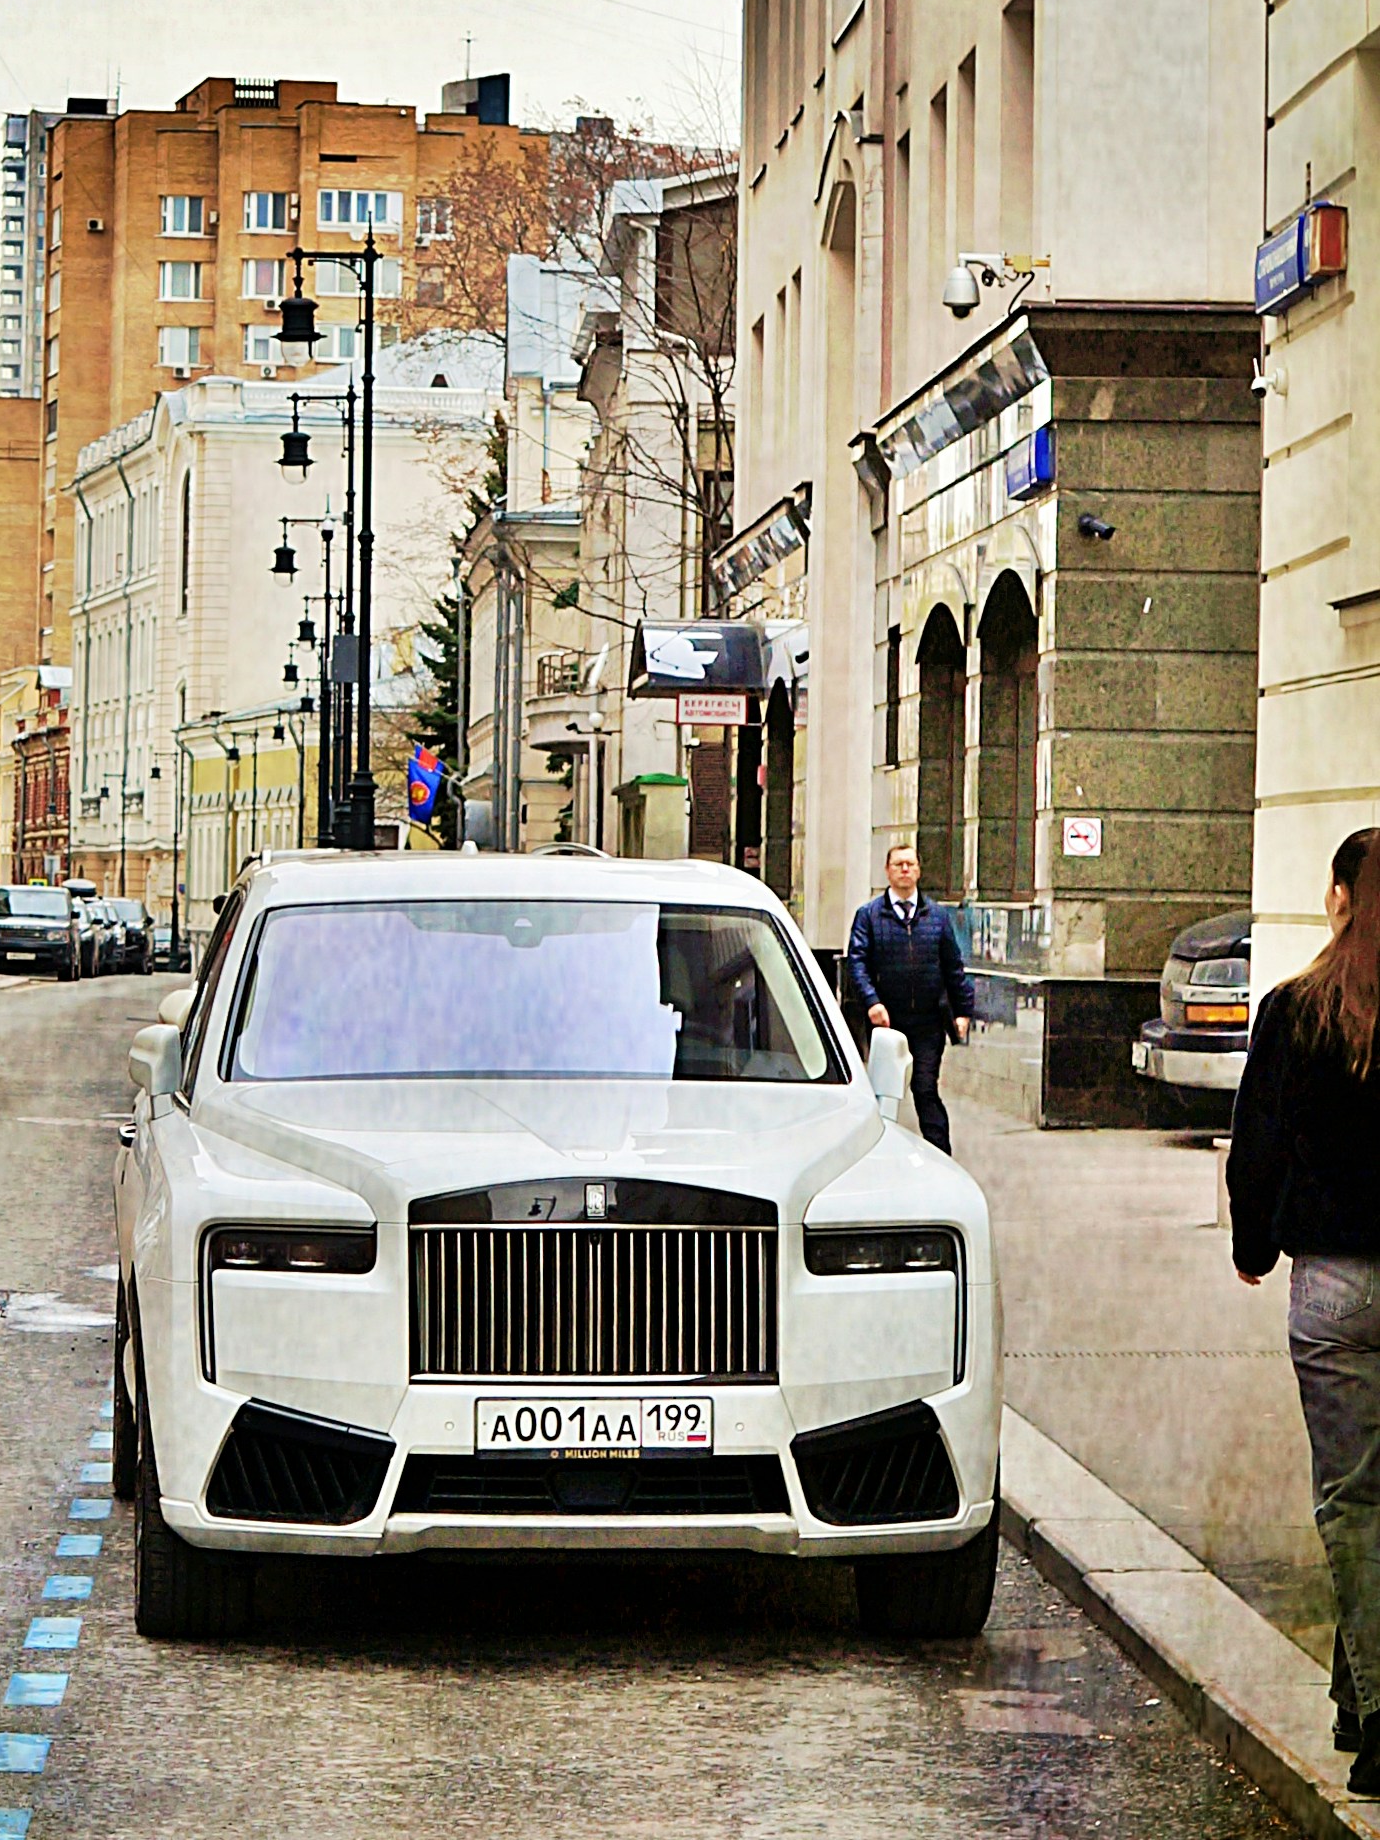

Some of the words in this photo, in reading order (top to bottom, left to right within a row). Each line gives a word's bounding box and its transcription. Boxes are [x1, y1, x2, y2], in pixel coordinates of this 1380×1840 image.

[646, 1404, 702, 1431] 199
[658, 1431, 686, 1442] RUS
[564, 1449, 608, 1459] MILLION
[609, 1449, 640, 1459] MILES
